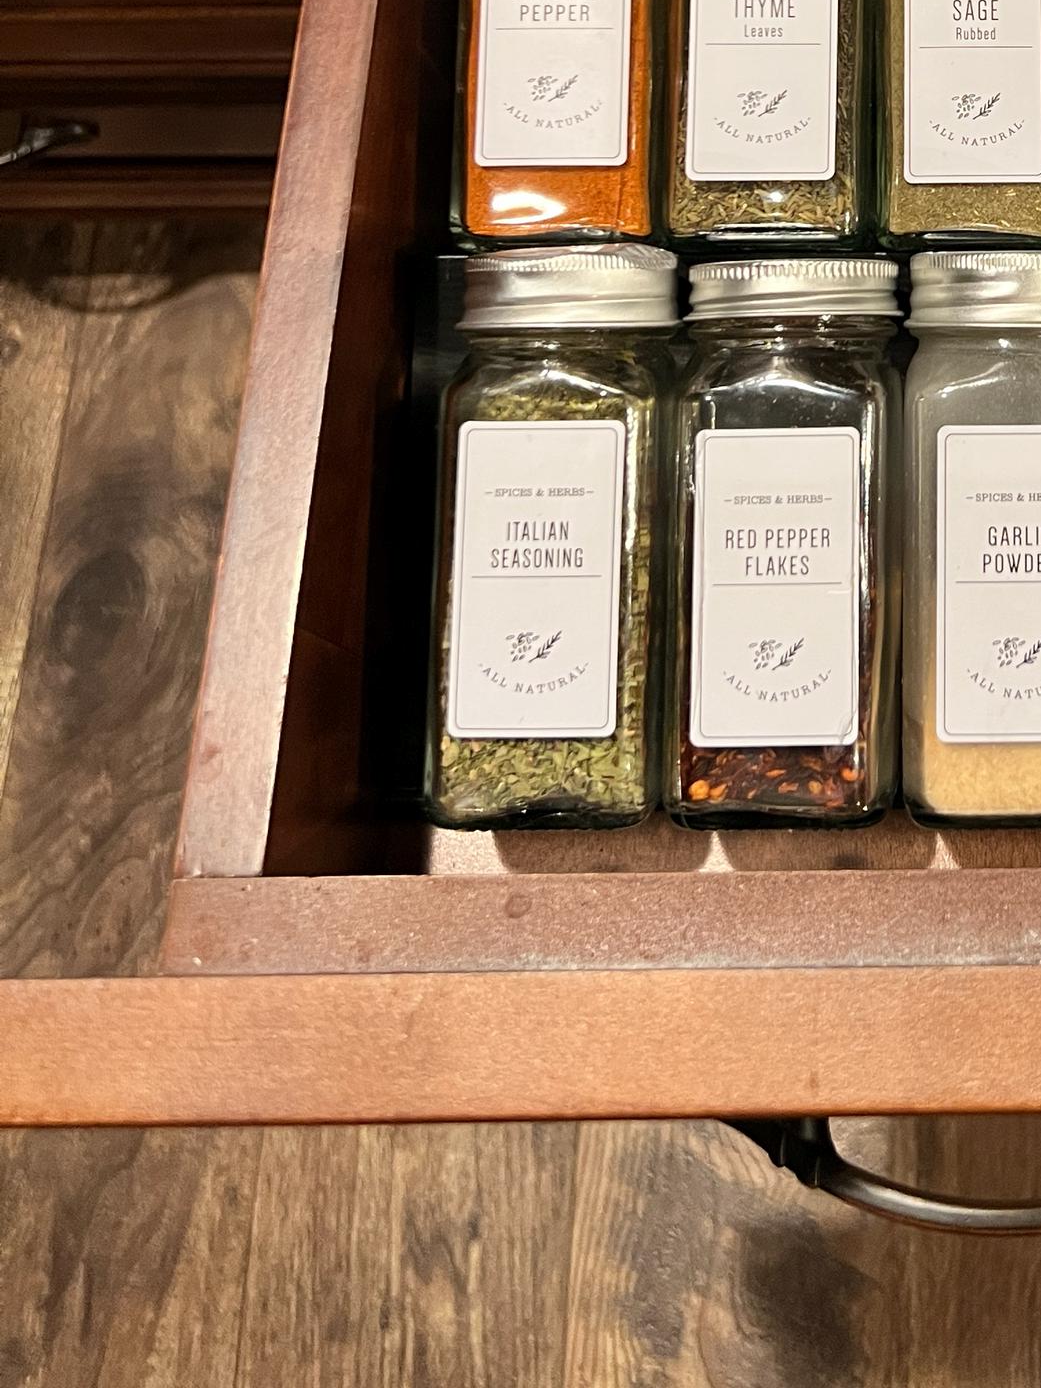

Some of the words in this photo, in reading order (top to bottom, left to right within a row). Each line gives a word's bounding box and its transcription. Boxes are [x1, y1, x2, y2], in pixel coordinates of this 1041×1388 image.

[520, 5, 590, 21] PEPPER
[952, 0, 999, 21] SAGE
[744, 24, 783, 37] Leaves
[956, 28, 996, 40] Rubbed
[506, 521, 569, 541] ITALIAN
[725, 529, 757, 549] RED
[765, 528, 830, 549] PEPPER
[491, 548, 583, 569] SEASONING
[745, 556, 809, 576] FLAKES
